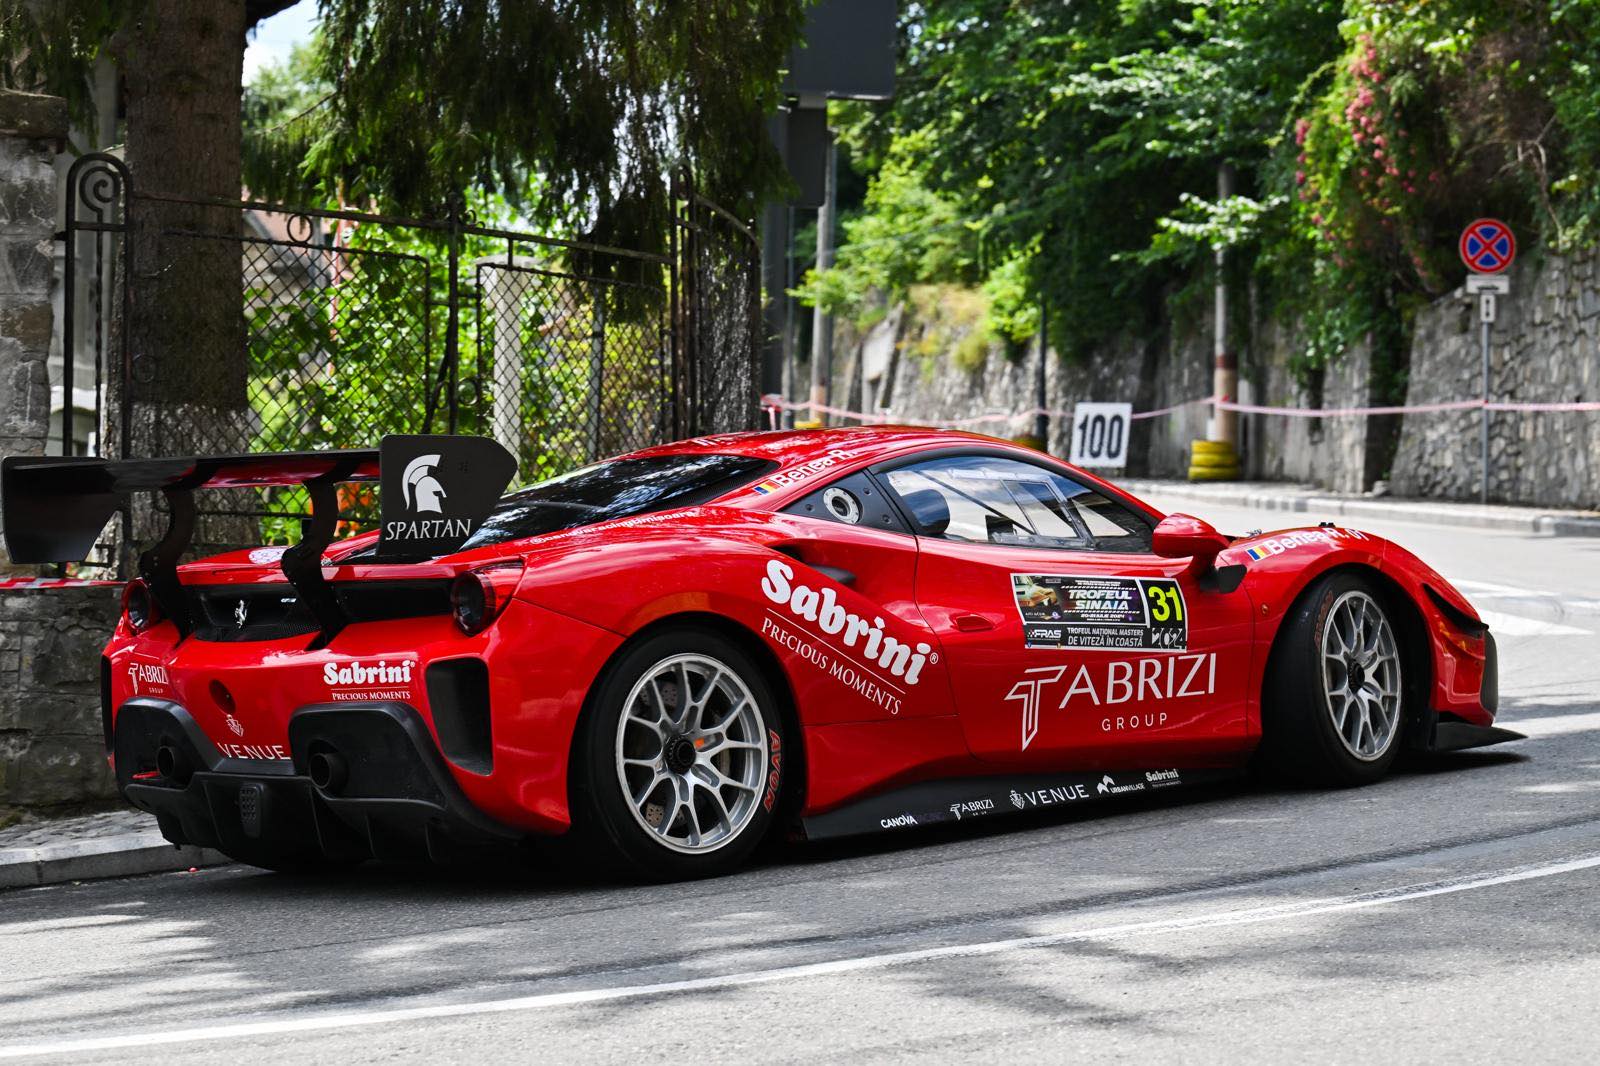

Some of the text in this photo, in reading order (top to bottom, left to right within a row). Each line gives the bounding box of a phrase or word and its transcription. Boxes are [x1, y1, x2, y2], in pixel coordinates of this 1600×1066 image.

[1079, 414, 1123, 459] 100
[770, 458, 837, 486] Benea
[385, 519, 472, 541] SPARTAN
[1263, 530, 1326, 555] Benea
[1068, 589, 1133, 600] TROFEUL
[1148, 586, 1183, 622] 31
[1074, 600, 1129, 610] SINAIA
[1034, 629, 1062, 639] FRAS
[1067, 627, 1091, 635] TROFEUL
[1067, 636, 1078, 645] DE
[761, 617, 902, 715] PRECIOUS MOMENTS
[332, 691, 411, 700] PRECIOUS MOMENTS
[1004, 653, 1217, 752] TABRIZI
[1101, 712, 1168, 731] GROUP
[217, 742, 292, 760] VENUE
[763, 728, 781, 813] AVON
[1145, 768, 1179, 782] Sabrini
[1024, 784, 1090, 806] VENUE
[880, 814, 919, 829] CANOVA
